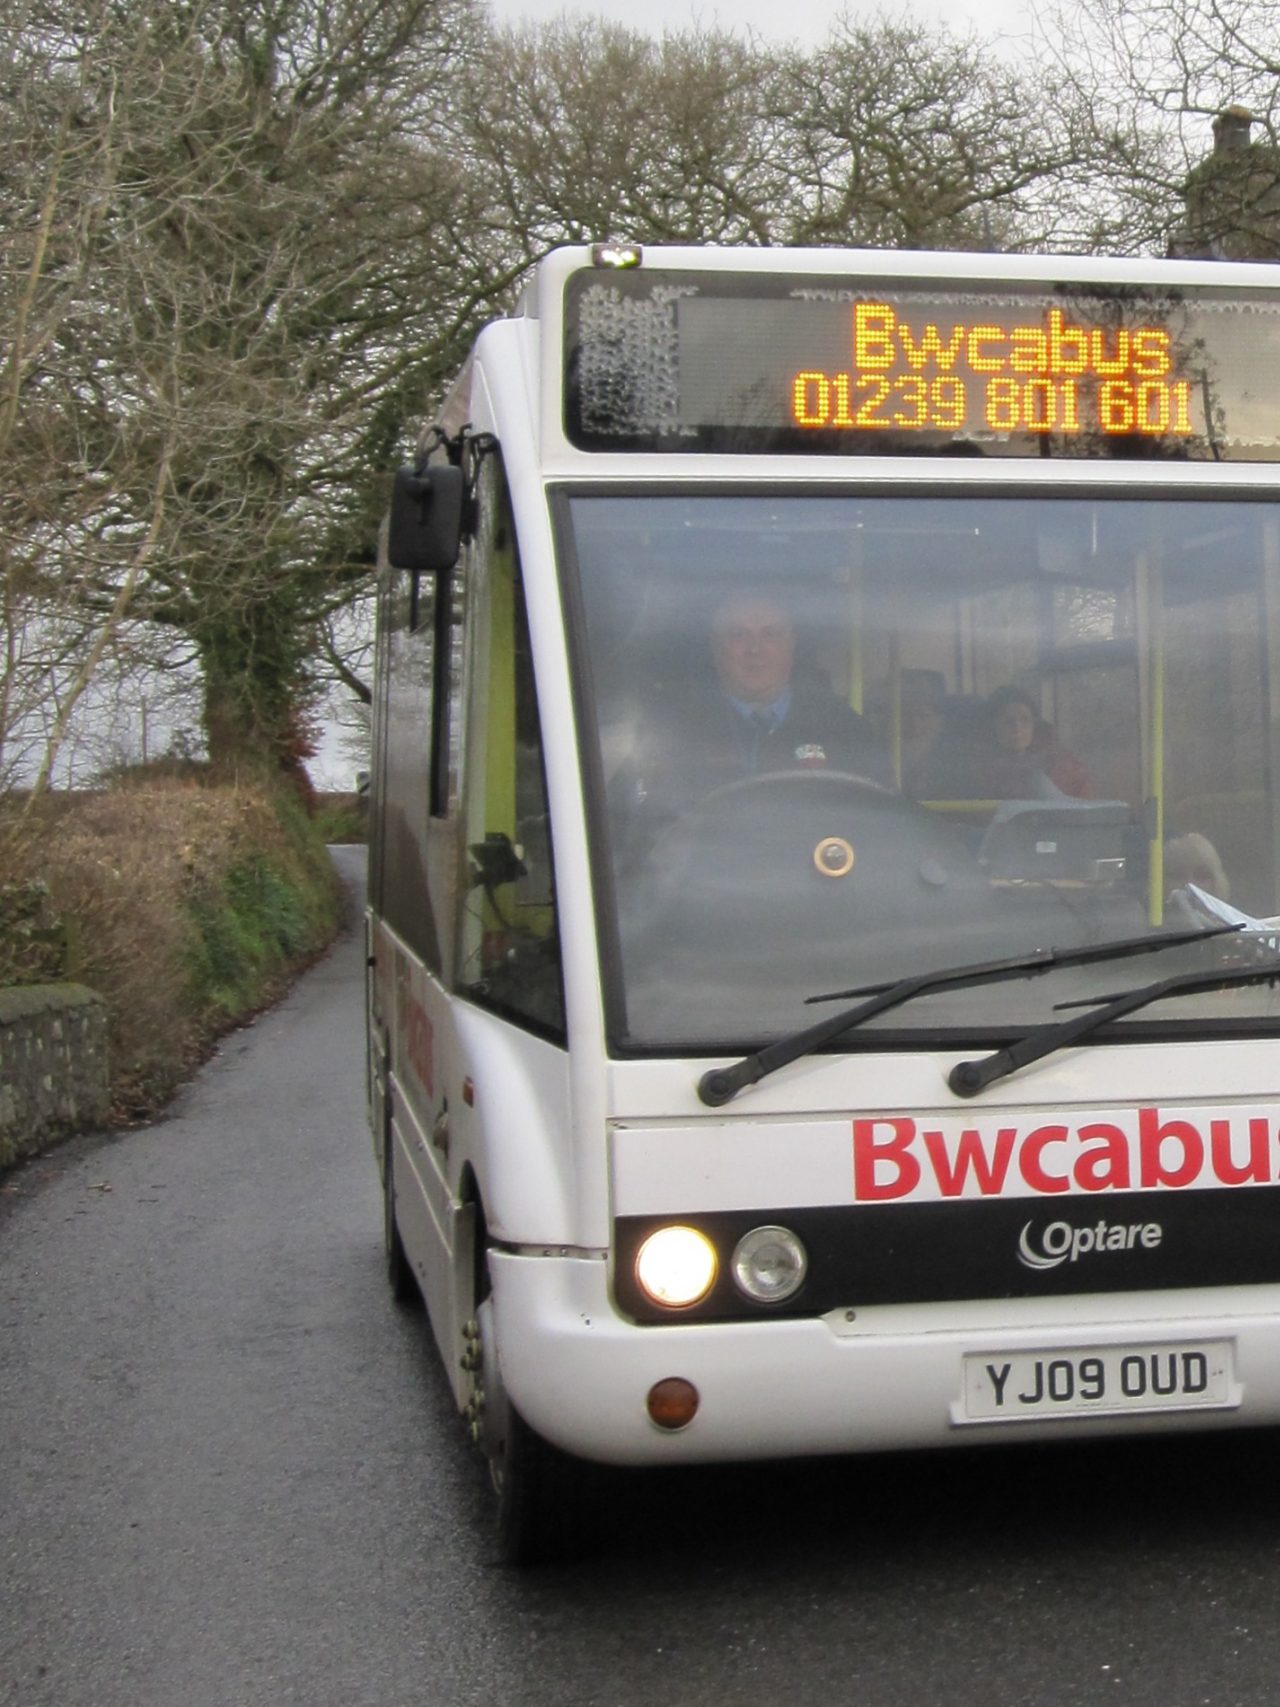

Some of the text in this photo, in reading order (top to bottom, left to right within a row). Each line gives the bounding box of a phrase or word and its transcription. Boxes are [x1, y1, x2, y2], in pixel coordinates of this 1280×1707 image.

[853, 302, 1173, 377] Bwcabus
[793, 371, 1193, 435] 01239 801 601
[1042, 1219, 1162, 1263] Optare
[986, 1351, 1208, 1406] YJ09 OUD
